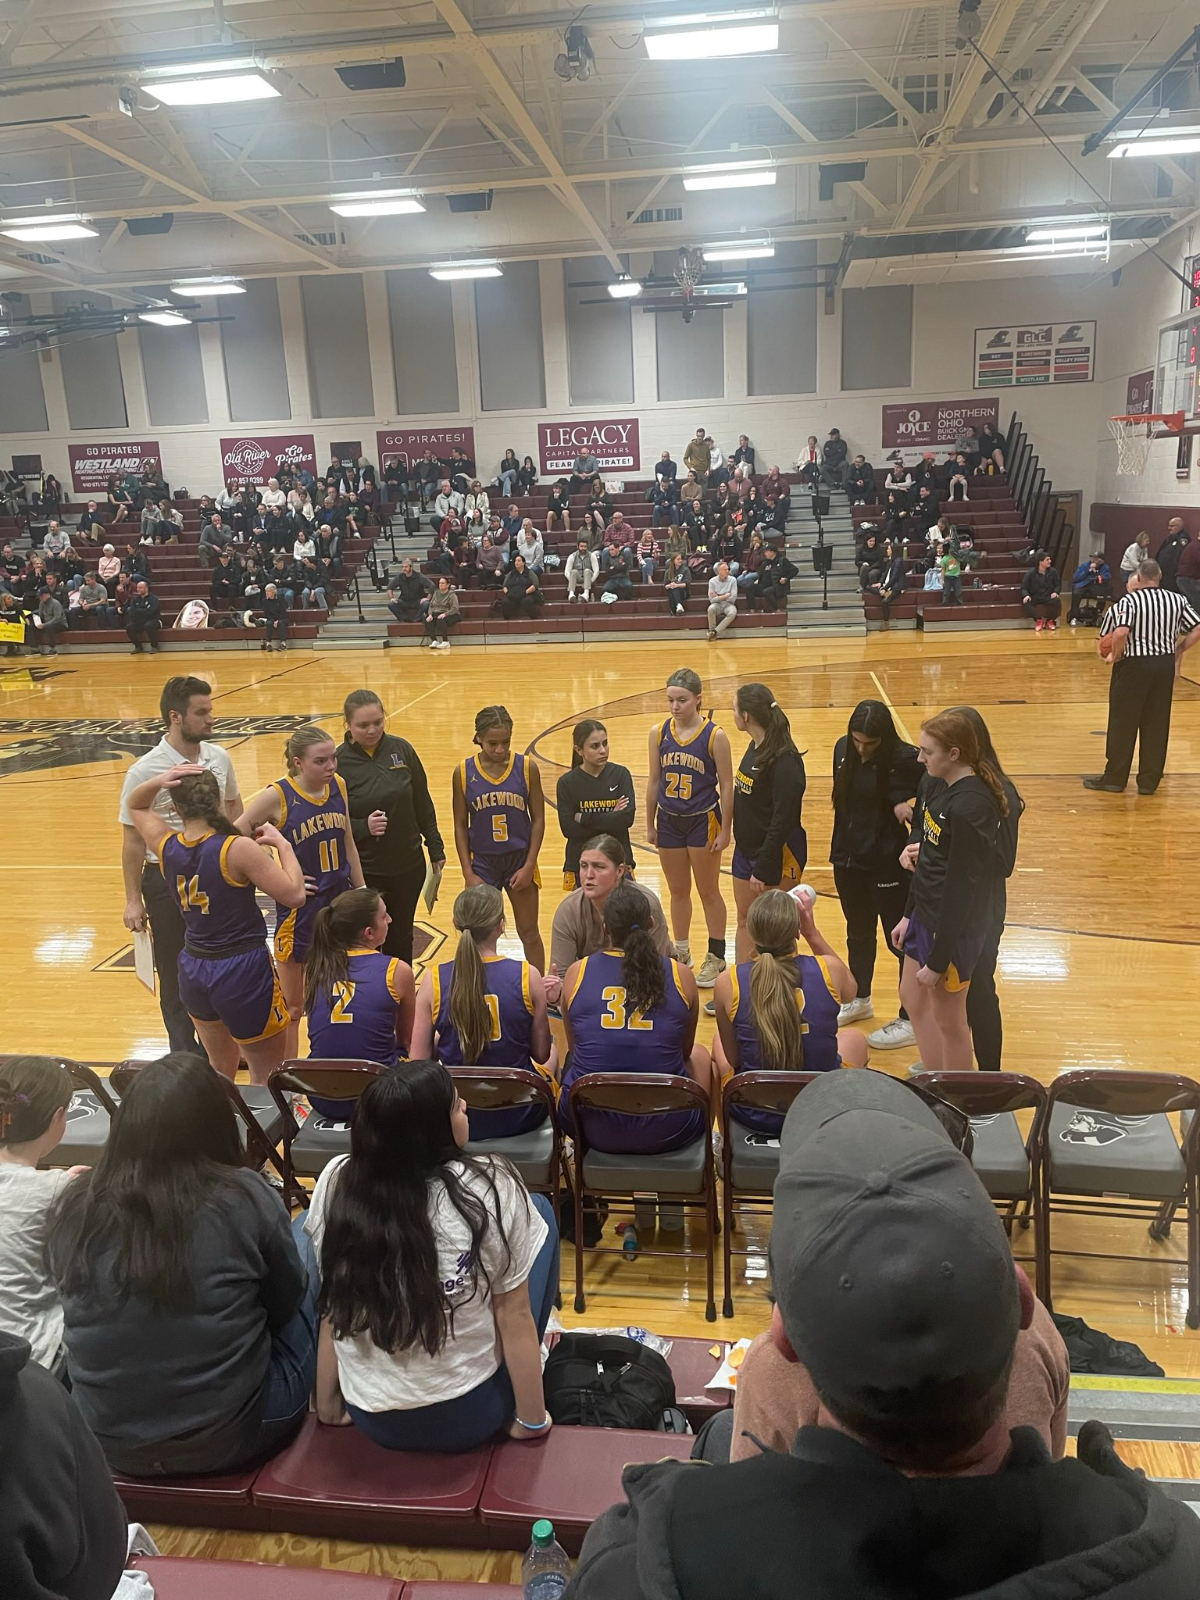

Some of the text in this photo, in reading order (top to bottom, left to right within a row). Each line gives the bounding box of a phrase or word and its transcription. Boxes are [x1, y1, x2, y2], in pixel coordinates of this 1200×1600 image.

[1024, 333, 1046, 342] GLC
[938, 407, 995, 419] NORTHERN
[897, 421, 931, 436] JOYCE
[937, 419, 963, 428] OHIO
[408, 433, 465, 443] PIRATES!
[545, 424, 632, 447] LEGACY
[86, 446, 141, 455] GO PIRATES!
[224, 449, 271, 466] Old River
[285, 445, 303, 456] Go
[75, 458, 139, 469] WESTLAND
[275, 453, 313, 466] Pirates
[660, 752, 705, 774] LAKEWOOD
[665, 772, 692, 800] 25
[580, 799, 618, 808] LAKEWOO
[292, 812, 346, 845] LAKEWOO
[492, 814, 509, 843] 5
[319, 838, 339, 873] 11
[176, 874, 210, 915] 14
[330, 981, 356, 1024] 2
